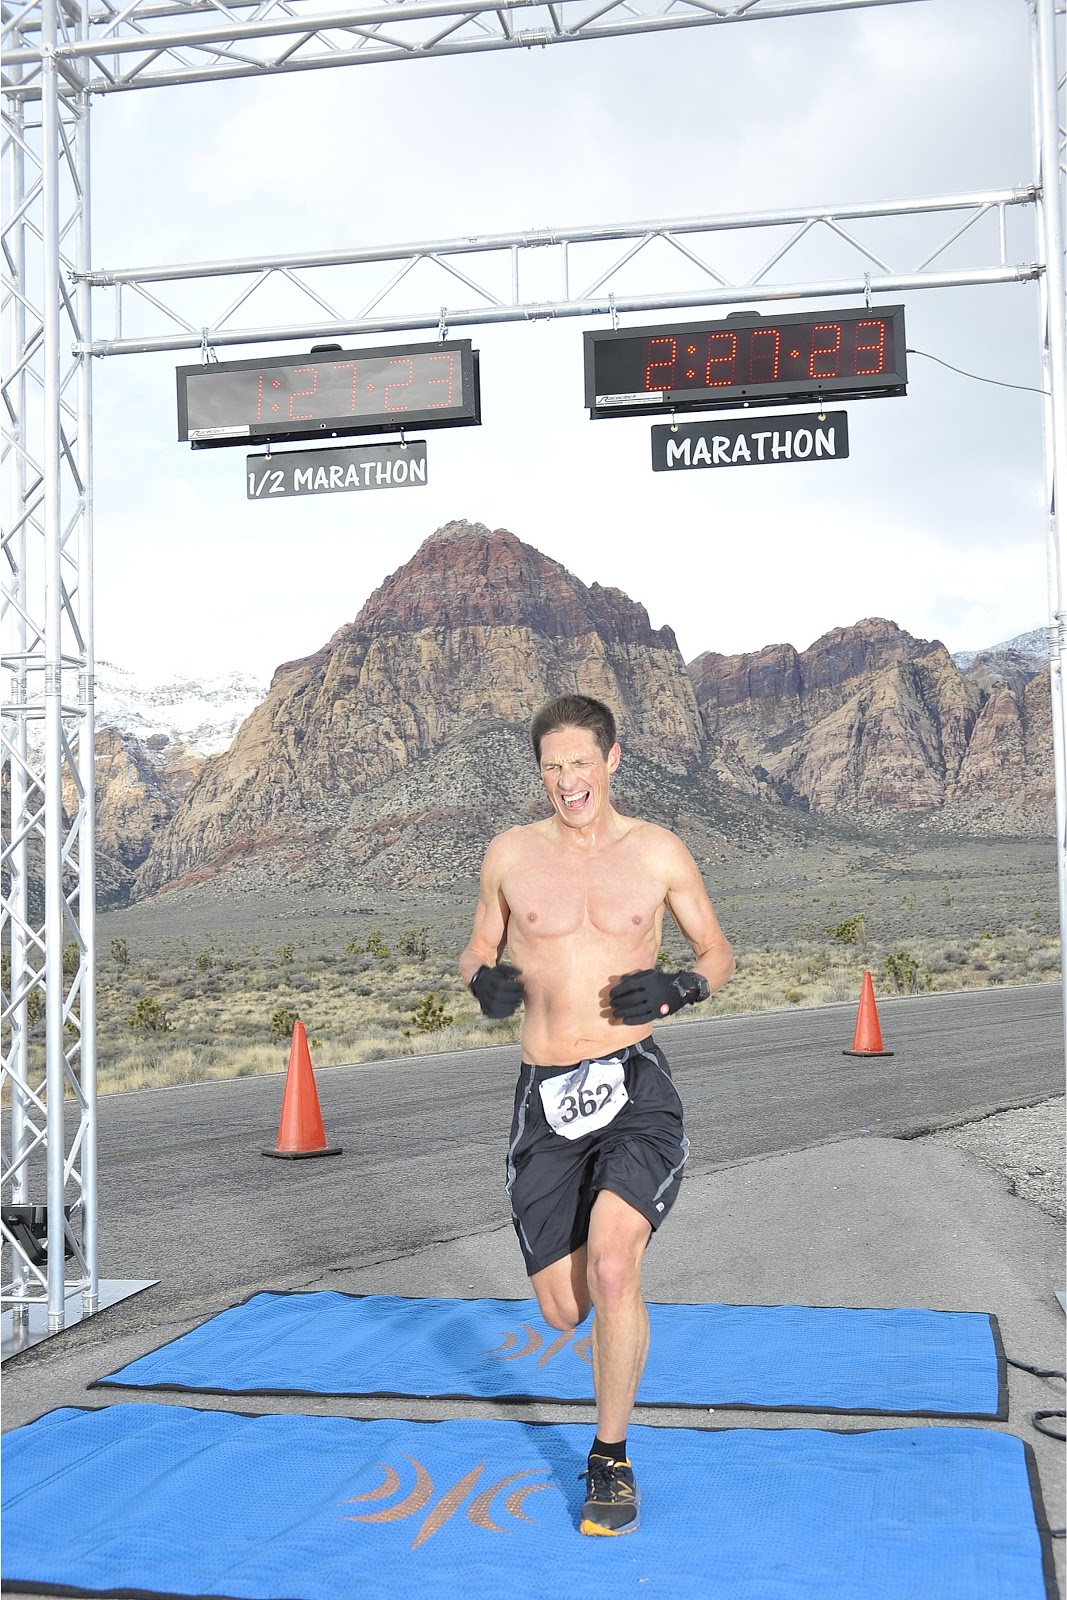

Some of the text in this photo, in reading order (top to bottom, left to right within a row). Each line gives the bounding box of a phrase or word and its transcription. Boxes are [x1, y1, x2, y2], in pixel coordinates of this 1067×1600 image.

[665, 427, 837, 468] MARATHON
[248, 458, 427, 497] 1/2 MARATHON
[557, 1083, 613, 1123] 362
